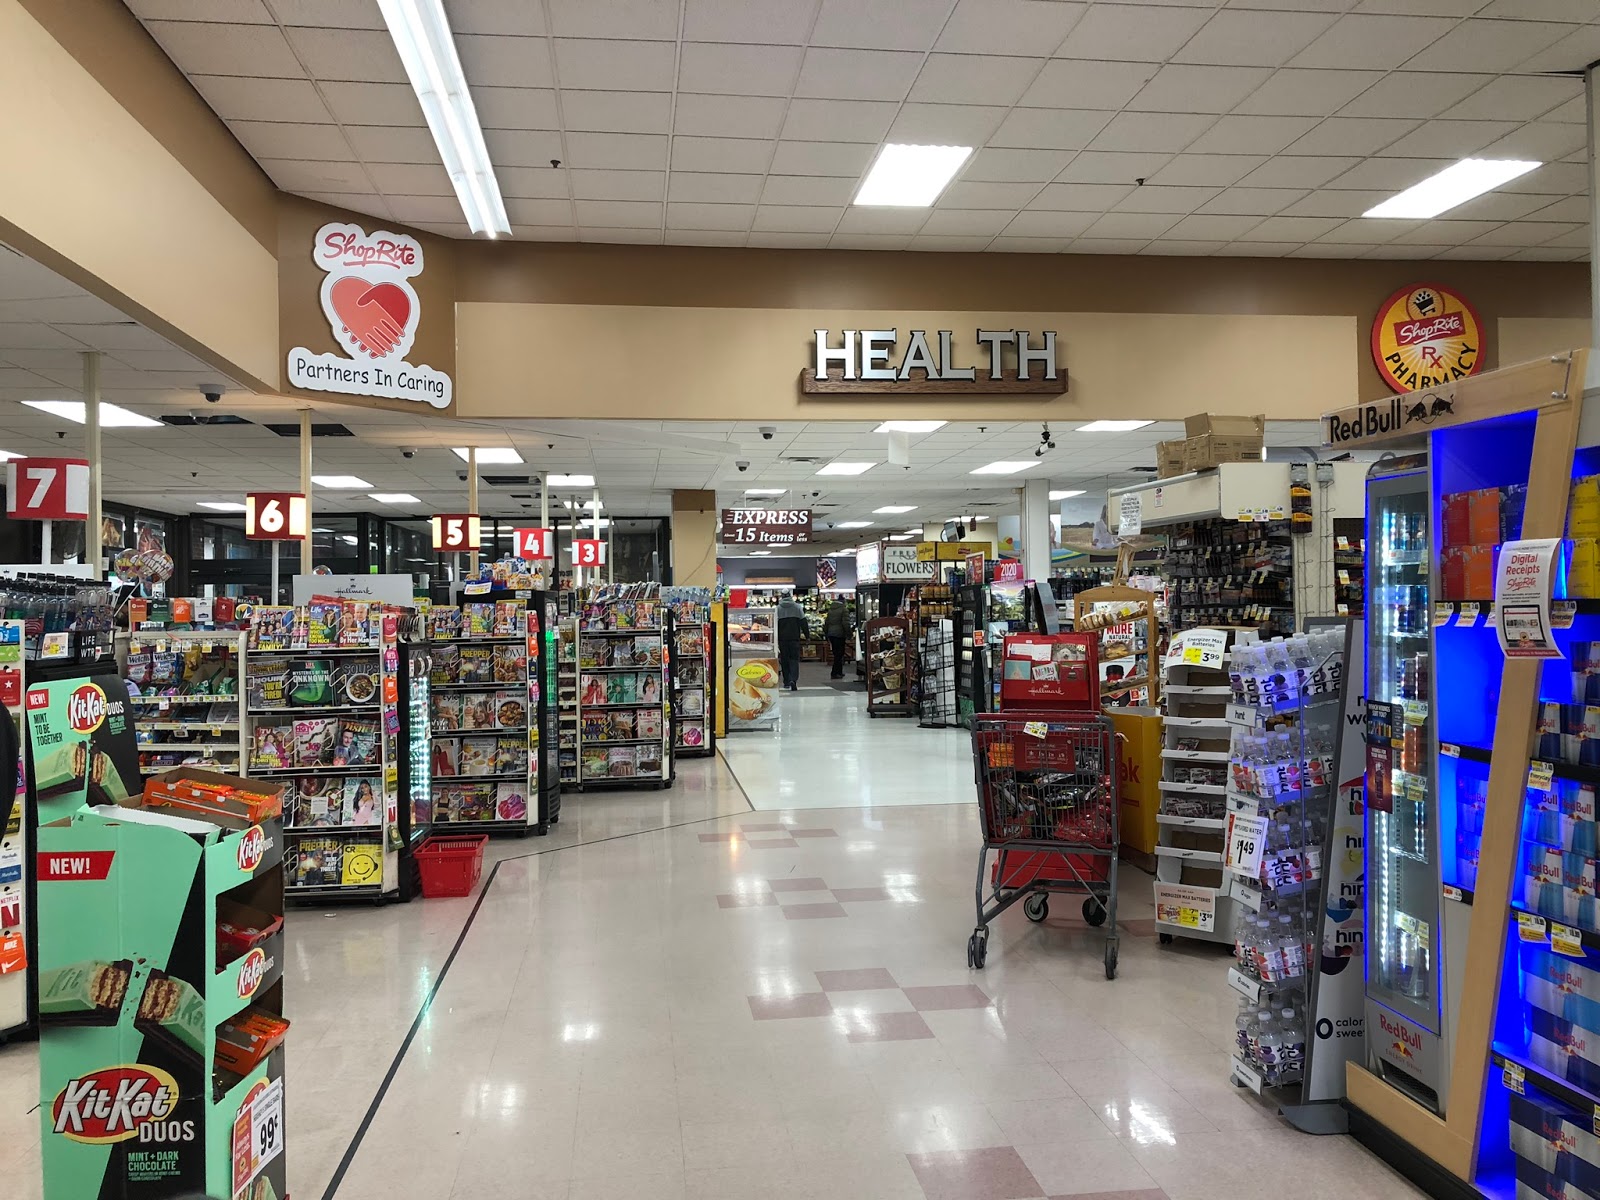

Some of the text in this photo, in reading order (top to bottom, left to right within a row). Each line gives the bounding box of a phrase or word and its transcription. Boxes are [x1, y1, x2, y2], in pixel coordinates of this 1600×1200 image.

[323, 232, 415, 269] ShopRite
[1400, 316, 1461, 345] ShopRite
[813, 328, 1057, 382] HEALTH
[1422, 346, 1443, 368] Rx
[1385, 343, 1477, 389] PHARMACY
[297, 358, 444, 398] Partners In Caring
[1330, 398, 1401, 443] Red Bull
[26, 467, 57, 508] 7
[259, 499, 285, 530] 6
[732, 510, 808, 525] EXPRESS
[446, 519, 464, 546] 5
[735, 527, 757, 543] 15
[759, 531, 794, 543] Items
[524, 533, 540, 555] 4
[582, 543, 595, 563] 3
[1511, 553, 1539, 566] Digital
[886, 562, 934, 574] FLOWERS
[1000, 563, 1017, 577] 2020
[1505, 565, 1541, 576] Receipts
[334, 587, 373, 595] Hallmark
[1507, 577, 1537, 591] ShopRite
[1106, 623, 1133, 634] MORE
[82, 635, 96, 645] LIFE
[81, 647, 95, 658] WTR
[343, 664, 380, 676] SOUPS
[30, 693, 46, 705] NEW!
[1028, 688, 1065, 696] Hallmark
[70, 691, 105, 729] KitKat
[107, 701, 125, 715] DUOS
[33, 713, 47, 724] MINT
[35, 724, 50, 736] TO BE
[1581, 723, 1596, 733] Bull
[36, 733, 63, 746] TOGETHER
[1542, 793, 1558, 806] Bull
[1576, 801, 1592, 815] Bull
[238, 832, 264, 869] KitKat
[300, 841, 338, 852] PREPPER
[50, 858, 90, 875] NEW!
[1542, 865, 1560, 878] Bull
[1566, 973, 1583, 989] Bull
[1379, 1013, 1422, 1051] Red Bull
[1570, 1035, 1586, 1052] Bull
[53, 1079, 170, 1134] KitKat
[140, 1120, 195, 1143] DUOS
[1560, 1132, 1576, 1149] Bull
[128, 1152, 149, 1161] MINT
[156, 1151, 179, 1161] DARK
[128, 1161, 176, 1171] CHOCOLATE
